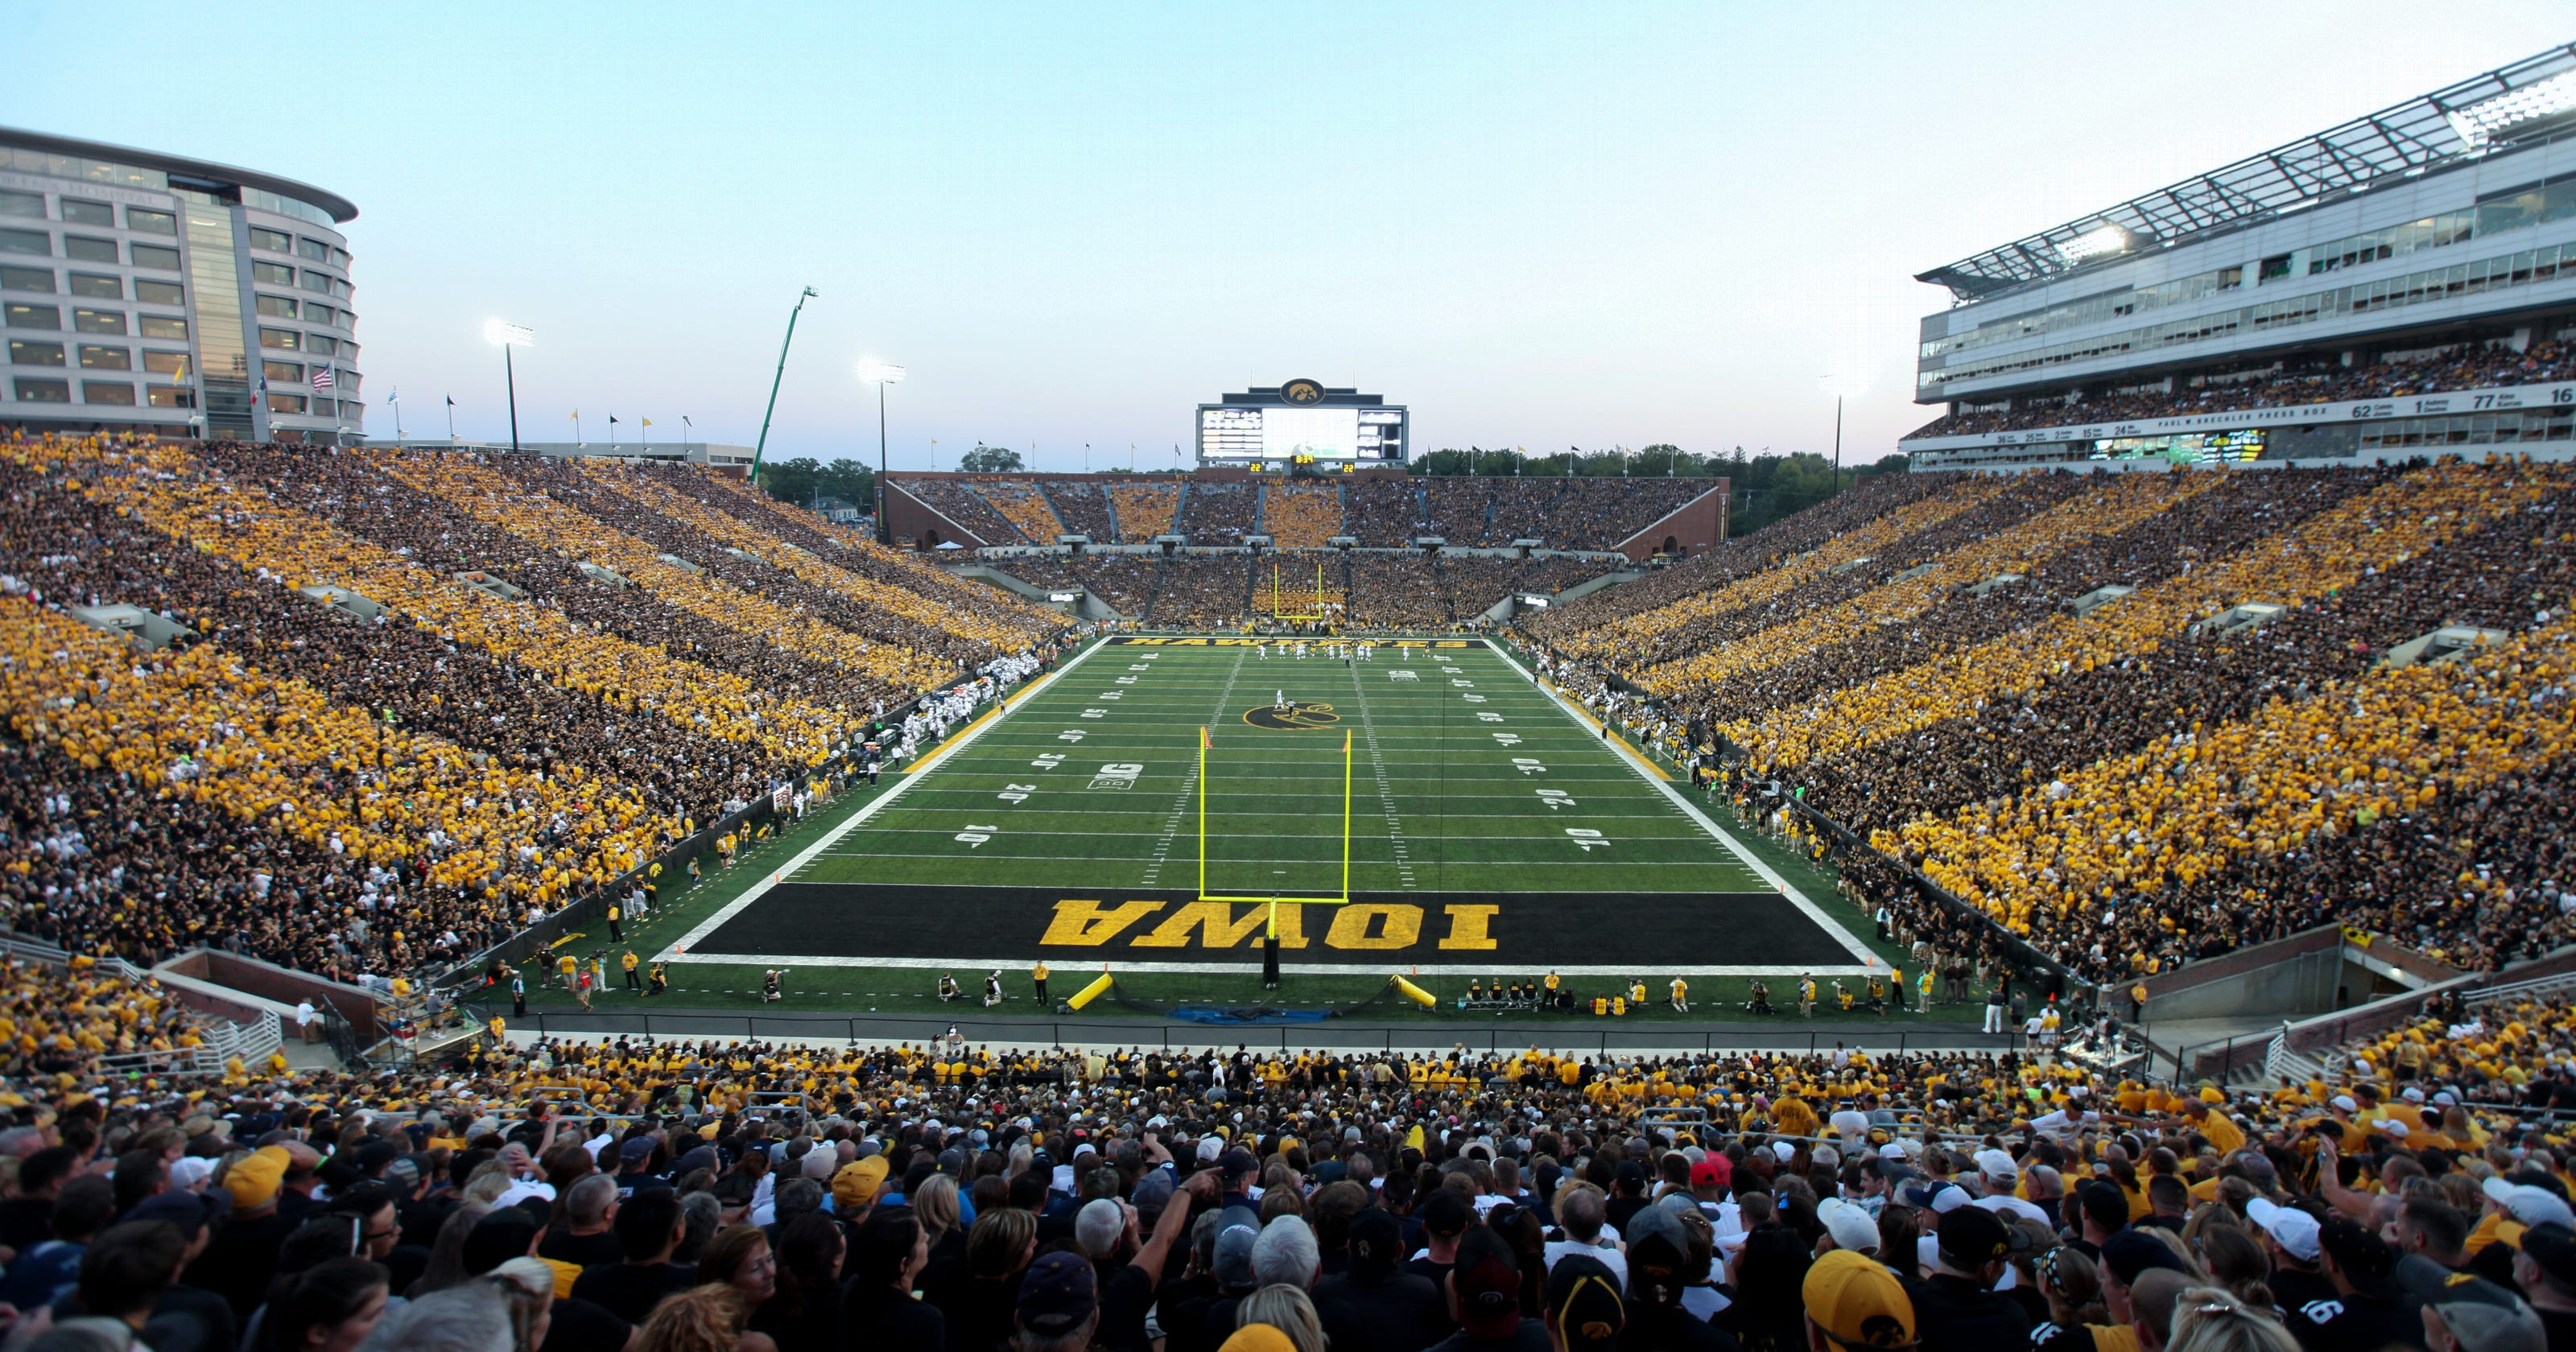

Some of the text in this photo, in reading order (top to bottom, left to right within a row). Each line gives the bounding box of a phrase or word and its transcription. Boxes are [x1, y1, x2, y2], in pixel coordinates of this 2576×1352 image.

[2474, 394, 2495, 409] 77
[2551, 388, 2574, 403] 16
[2352, 405, 2371, 418] 62
[2416, 400, 2423, 413] 1
[2158, 418, 2182, 427] PAUL
[2258, 409, 2295, 418] PRESS
[2303, 407, 2327, 415] BOX
[2054, 431, 2060, 439] 2
[2083, 428, 2091, 438] 15
[2115, 425, 2126, 435] 24
[2025, 433, 2034, 442] 25
[1250, 464, 1261, 472] 22
[1344, 464, 1353, 473] 22
[1123, 638, 1468, 647] HAWKEYES
[1080, 708, 1108, 718] 50
[1476, 712, 1505, 722] 50
[1058, 729, 1088, 740] 40
[1492, 733, 1522, 744] 40
[1030, 753, 1067, 767] 30
[1511, 758, 1546, 772] 30
[997, 783, 1037, 800] 20
[1535, 789, 1576, 806] 20
[954, 824, 997, 843] 10
[1565, 828, 1611, 846] 10
[1039, 900, 1500, 950] IOWA
